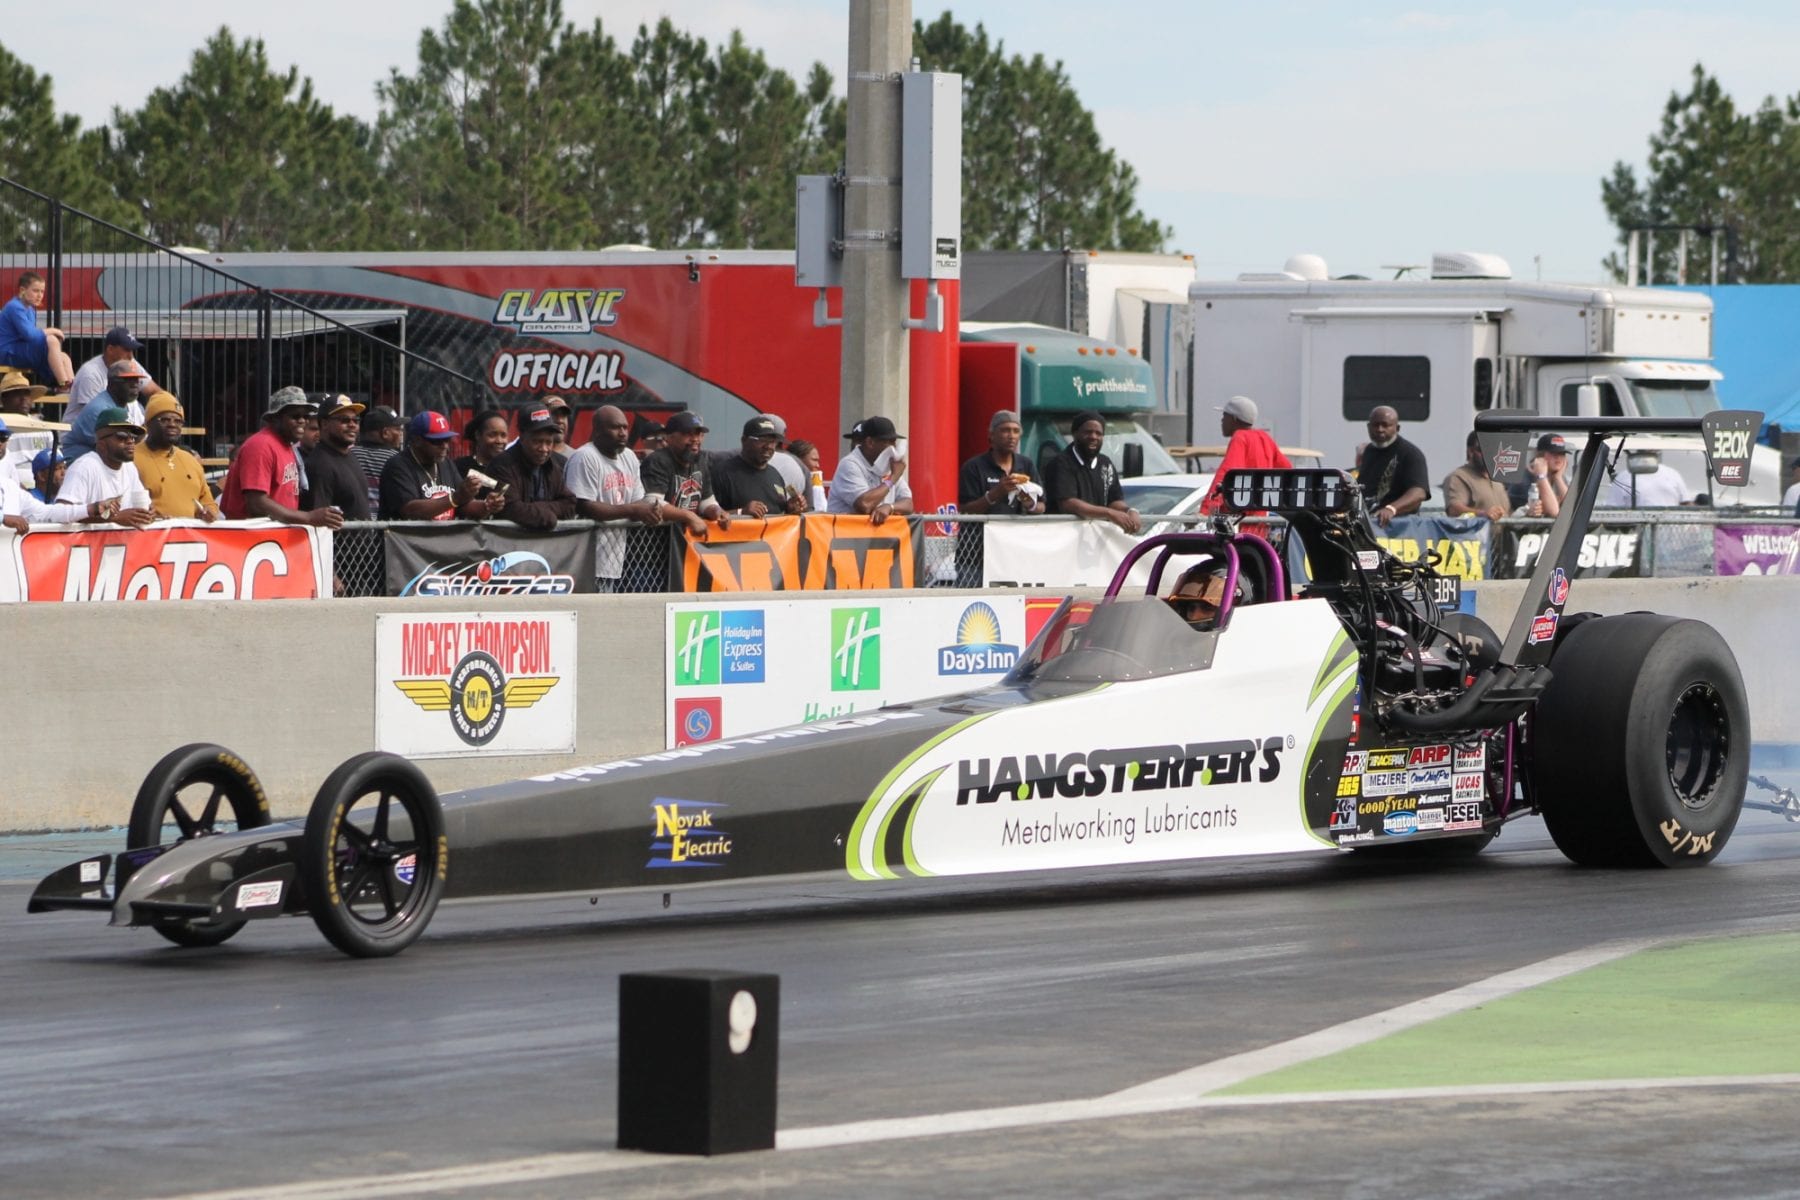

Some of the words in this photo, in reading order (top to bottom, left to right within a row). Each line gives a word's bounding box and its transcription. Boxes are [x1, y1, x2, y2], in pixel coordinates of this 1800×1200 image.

[493, 352, 622, 390] OFFICIAL
[1515, 533, 1638, 568] PSKE
[724, 626, 750, 640] Holiday
[402, 622, 462, 676] MICKEY
[465, 620, 551, 675] THOMPSON
[724, 640, 762, 660] Express
[942, 650, 986, 673] Days
[988, 649, 1015, 668] Inn
[455, 659, 501, 689] PERFORMANCE
[736, 661, 755, 671] Suites
[454, 703, 470, 735] TIRES
[1409, 745, 1450, 764] ARP
[955, 736, 1284, 806] HANGSTERFER'S
[1370, 772, 1406, 786] MEZIERE
[1455, 775, 1481, 790] LUCAS
[1455, 790, 1472, 799] RACING
[654, 803, 713, 838] Novak
[1001, 808, 1136, 847] Metalworking
[1144, 804, 1238, 835] Lubricants
[1444, 803, 1481, 823] JESEL
[671, 829, 732, 863] Electric
